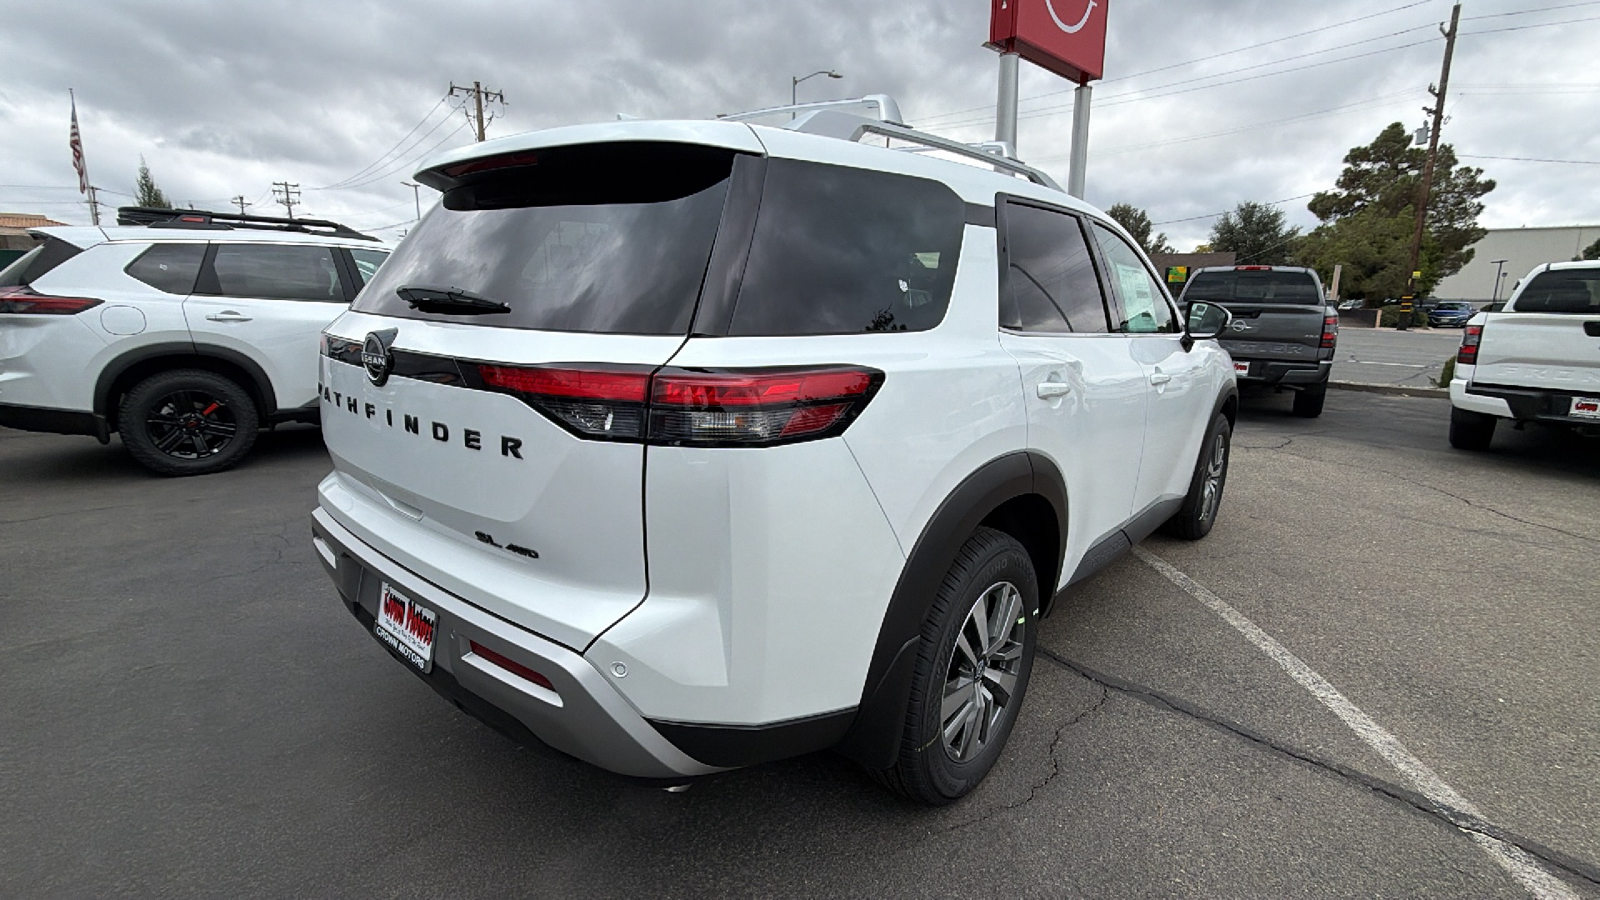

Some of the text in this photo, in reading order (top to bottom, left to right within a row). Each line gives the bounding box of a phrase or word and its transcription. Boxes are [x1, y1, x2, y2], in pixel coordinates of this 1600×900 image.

[318, 382, 524, 460] PATHFINDER
[475, 531, 503, 548] SL
[376, 626, 399, 649] CROWN
[398, 642, 425, 669] MOTORS
